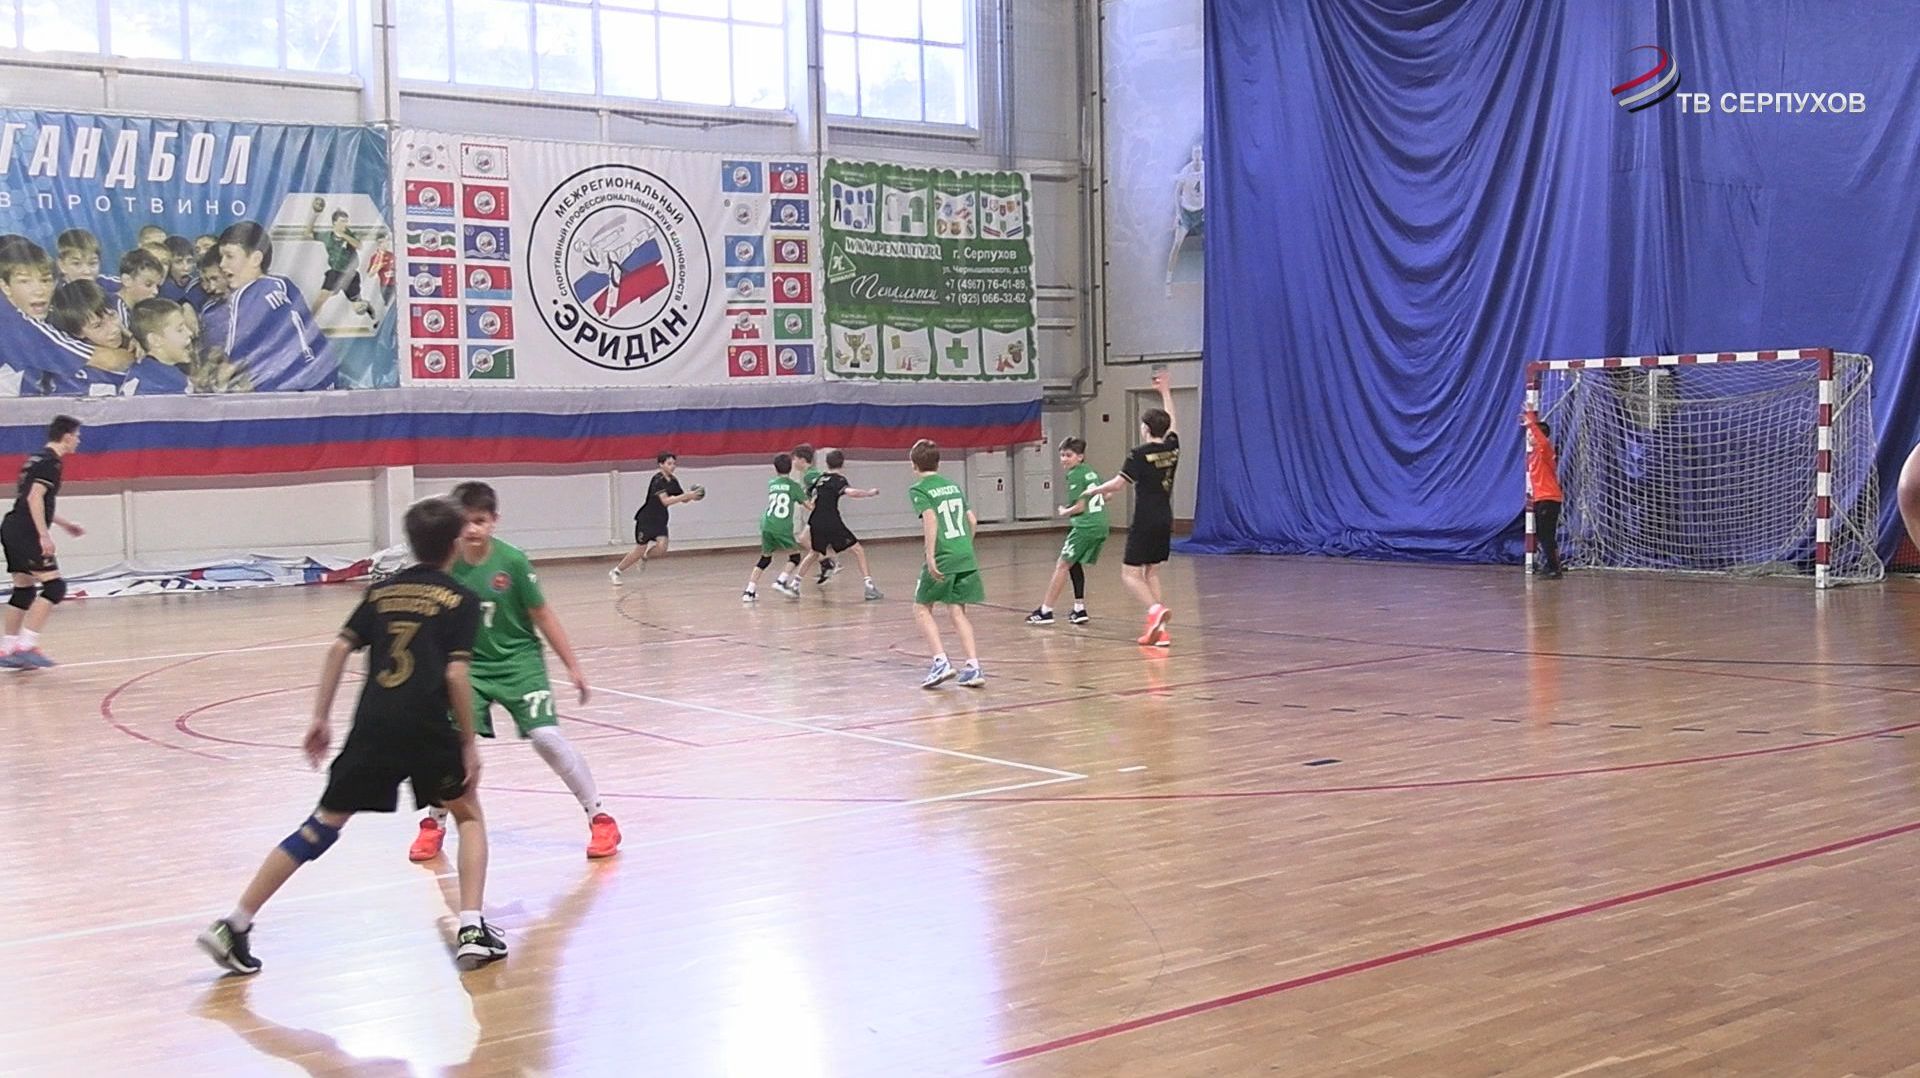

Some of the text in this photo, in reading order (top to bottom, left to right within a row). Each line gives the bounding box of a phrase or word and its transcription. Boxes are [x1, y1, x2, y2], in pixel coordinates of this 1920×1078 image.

[0, 122, 251, 189] ГАНДБОЛ
[0, 191, 246, 216] В ПРОТВИНО
[554, 177, 684, 225] МЕЖРЕГИОНАЛЬНЫЙ
[554, 226, 568, 297] СПОРТИВНЫЙ
[565, 193, 655, 230] ПРОФЕССИОНАЛЬНЫЙ
[653, 209, 673, 230] КЛУБ
[669, 230, 686, 301] ЕДИНОБОРСТВ
[964, 247, 1017, 262] Серпухов
[554, 302, 688, 366] ЭРИДАН
[767, 492, 790, 519] 78
[937, 498, 966, 539] 17
[375, 621, 422, 689] 3
[522, 690, 553, 719] 77
